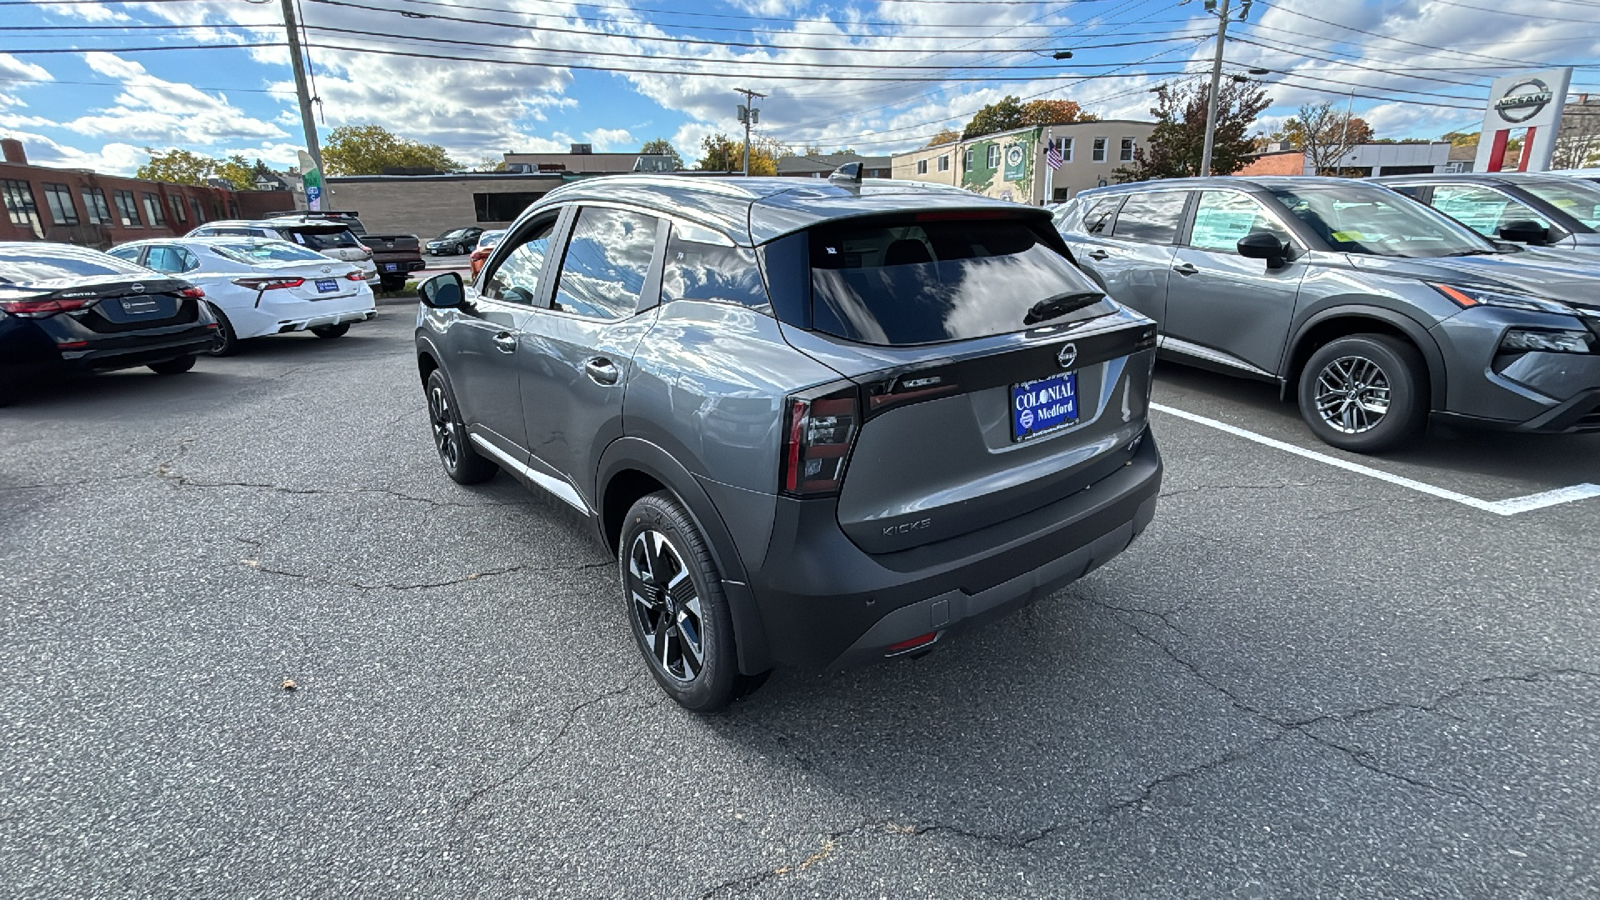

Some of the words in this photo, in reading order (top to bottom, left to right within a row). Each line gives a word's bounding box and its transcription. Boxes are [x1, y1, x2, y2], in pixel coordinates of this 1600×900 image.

[1499, 93, 1546, 106] NISSAN
[1016, 382, 1074, 411] COLONIAL
[1037, 400, 1073, 421] Medford
[882, 517, 931, 536] KICKS
